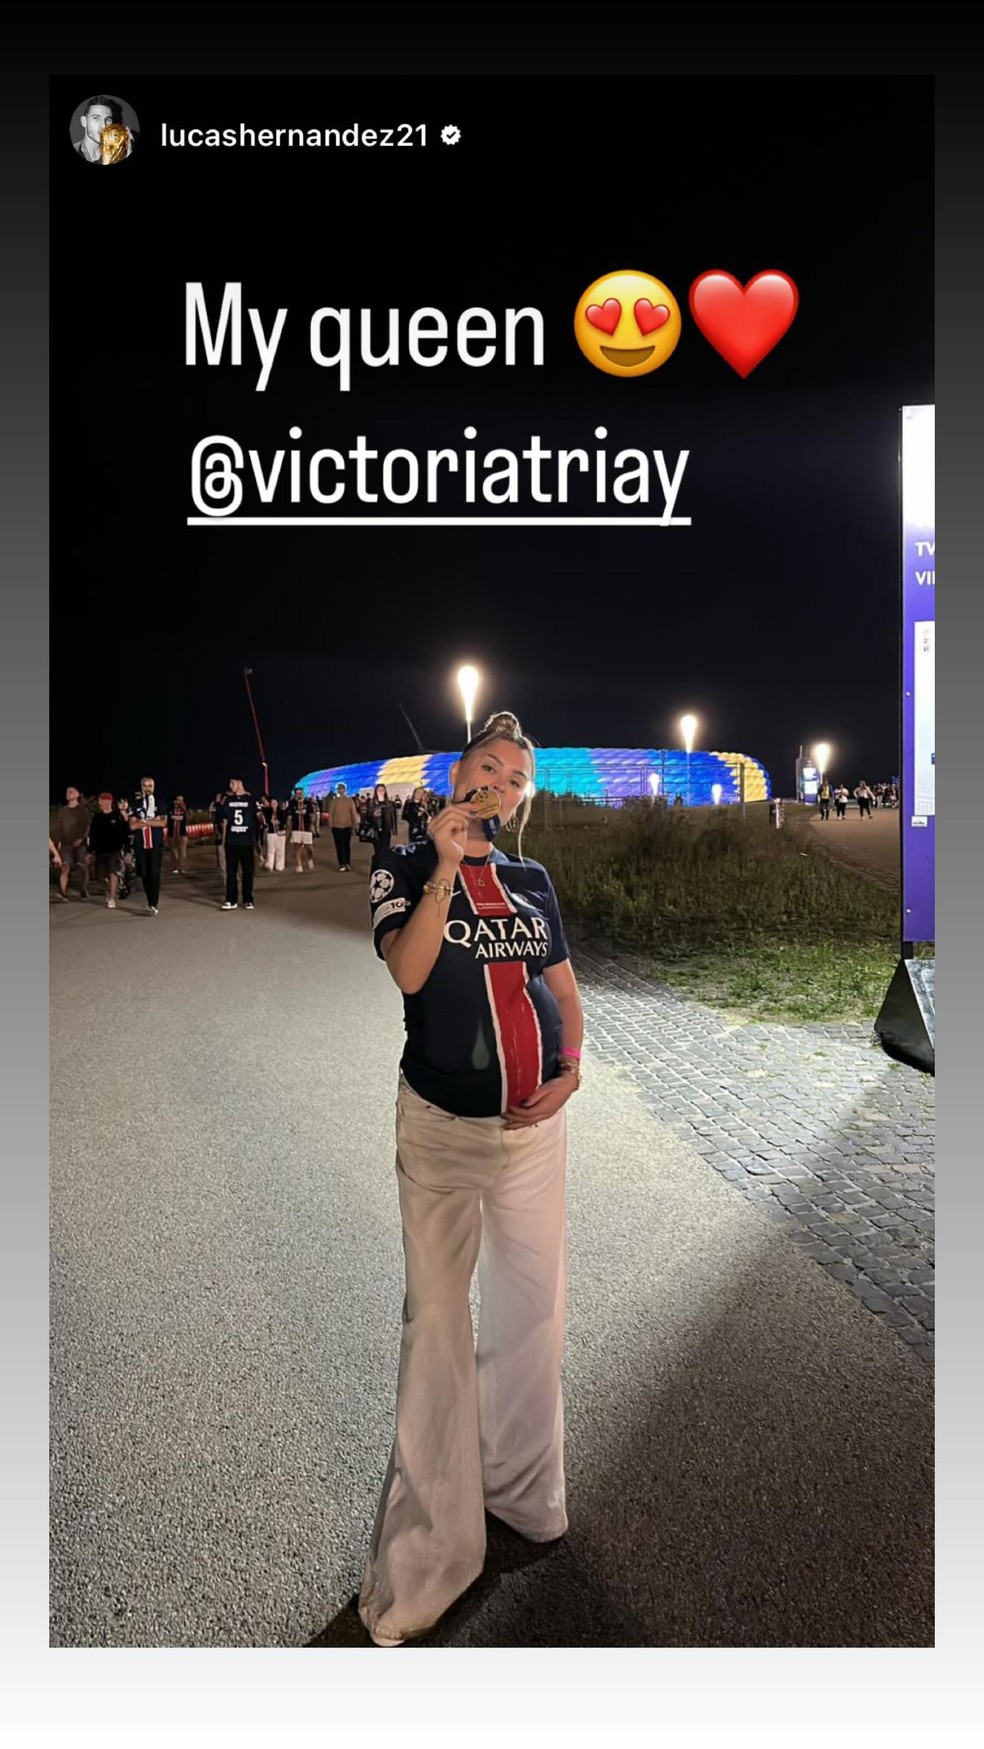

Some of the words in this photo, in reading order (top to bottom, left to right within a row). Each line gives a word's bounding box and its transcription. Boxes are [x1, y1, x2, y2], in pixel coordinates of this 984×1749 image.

[233, 809, 243, 825] 5
[443, 917, 548, 948] QATAR
[475, 941, 548, 959] AIRWAYS
